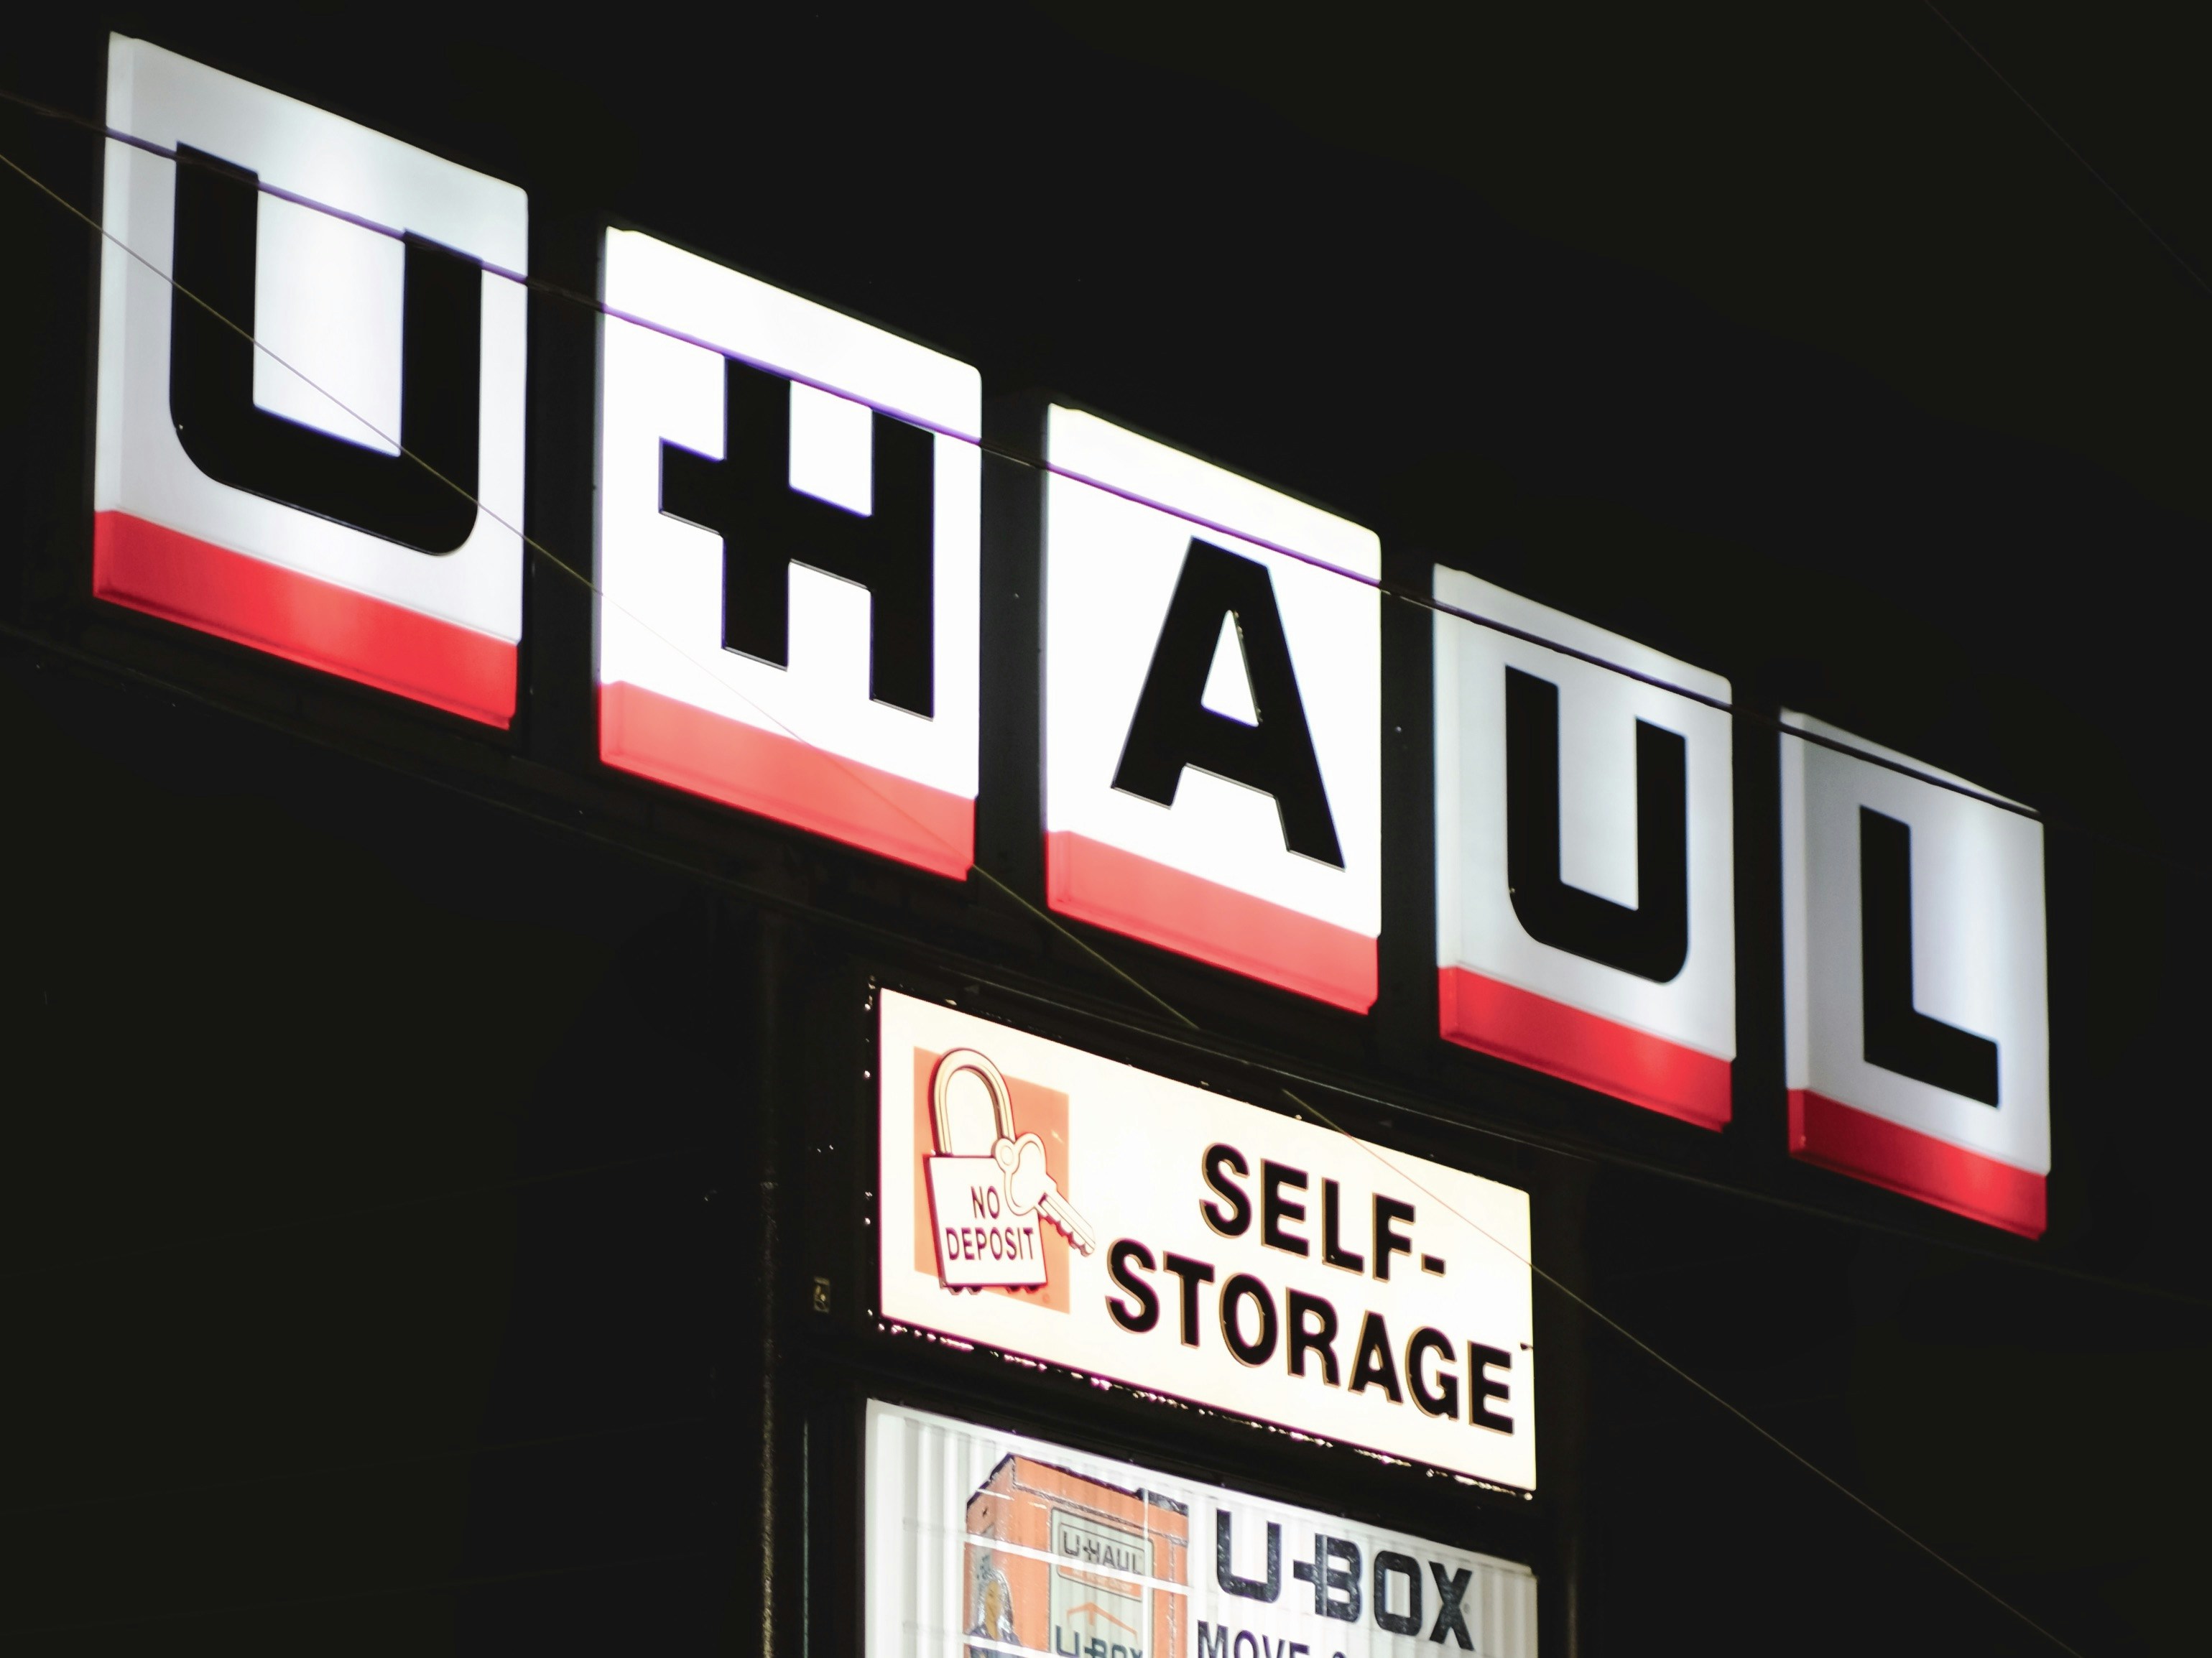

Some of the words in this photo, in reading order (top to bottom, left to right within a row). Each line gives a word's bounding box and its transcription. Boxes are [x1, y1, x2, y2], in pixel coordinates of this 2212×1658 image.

[945, 1227, 1034, 1261] DEPOSIT
[971, 1185, 1000, 1219] NO
[1199, 1143, 1446, 1282] SELF-
[1104, 1238, 1515, 1435] STORAGE
[1216, 1508, 1475, 1652] U-BOX
